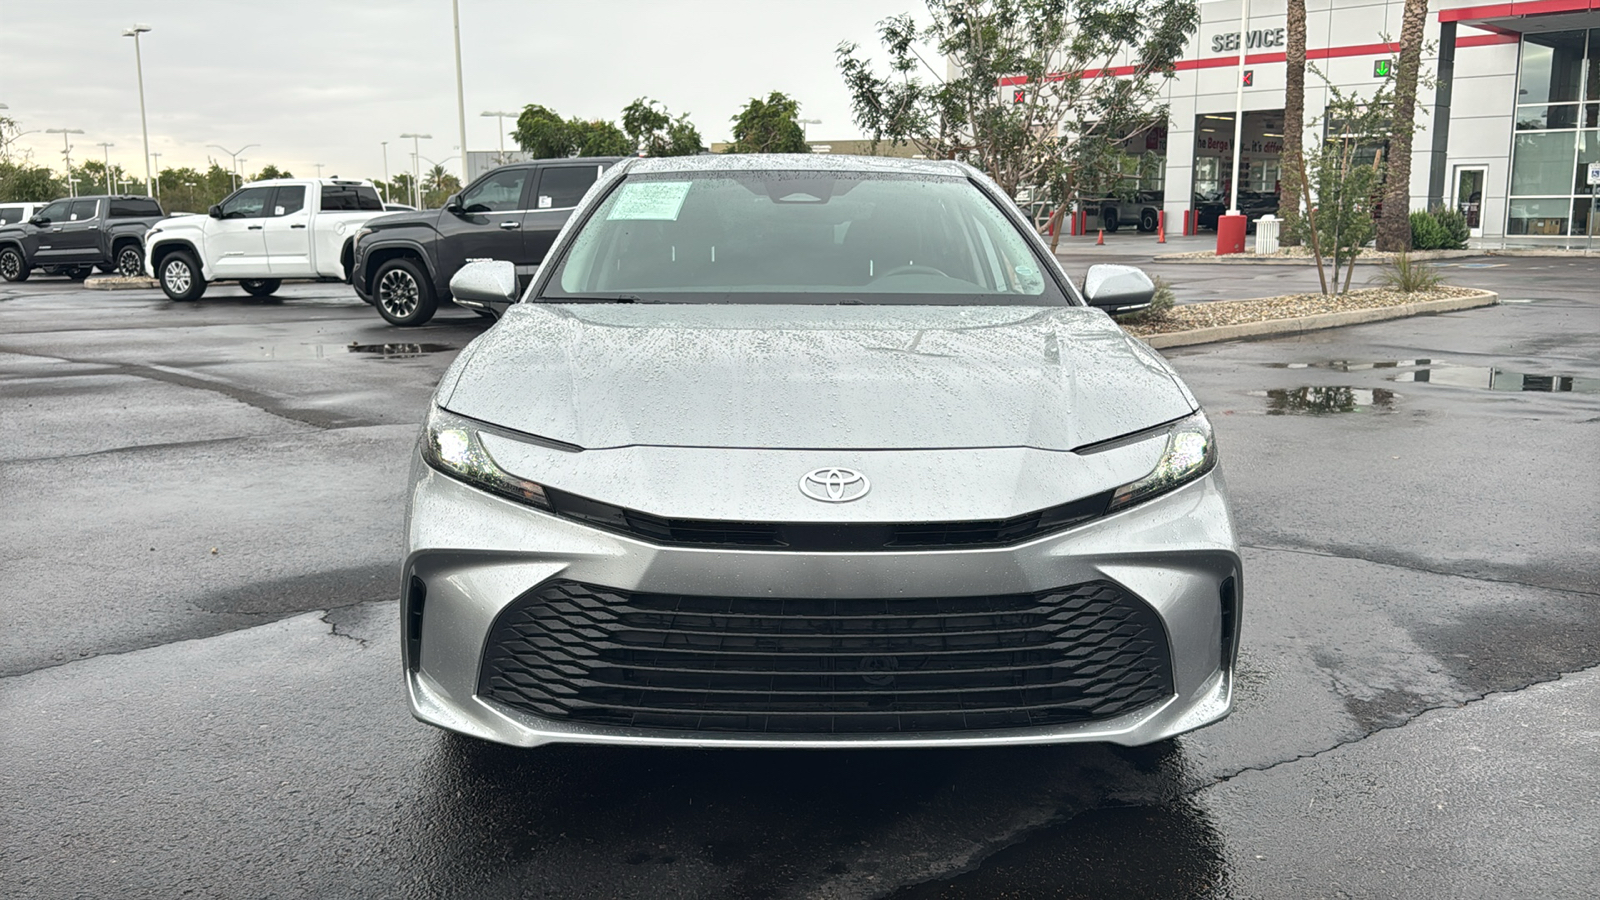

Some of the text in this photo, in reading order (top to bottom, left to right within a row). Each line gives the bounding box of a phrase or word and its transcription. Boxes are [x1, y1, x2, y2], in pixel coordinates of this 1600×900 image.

[1212, 27, 1285, 52] SERVICE
[1197, 135, 1206, 148] he
[1207, 137, 1228, 152] Berge
